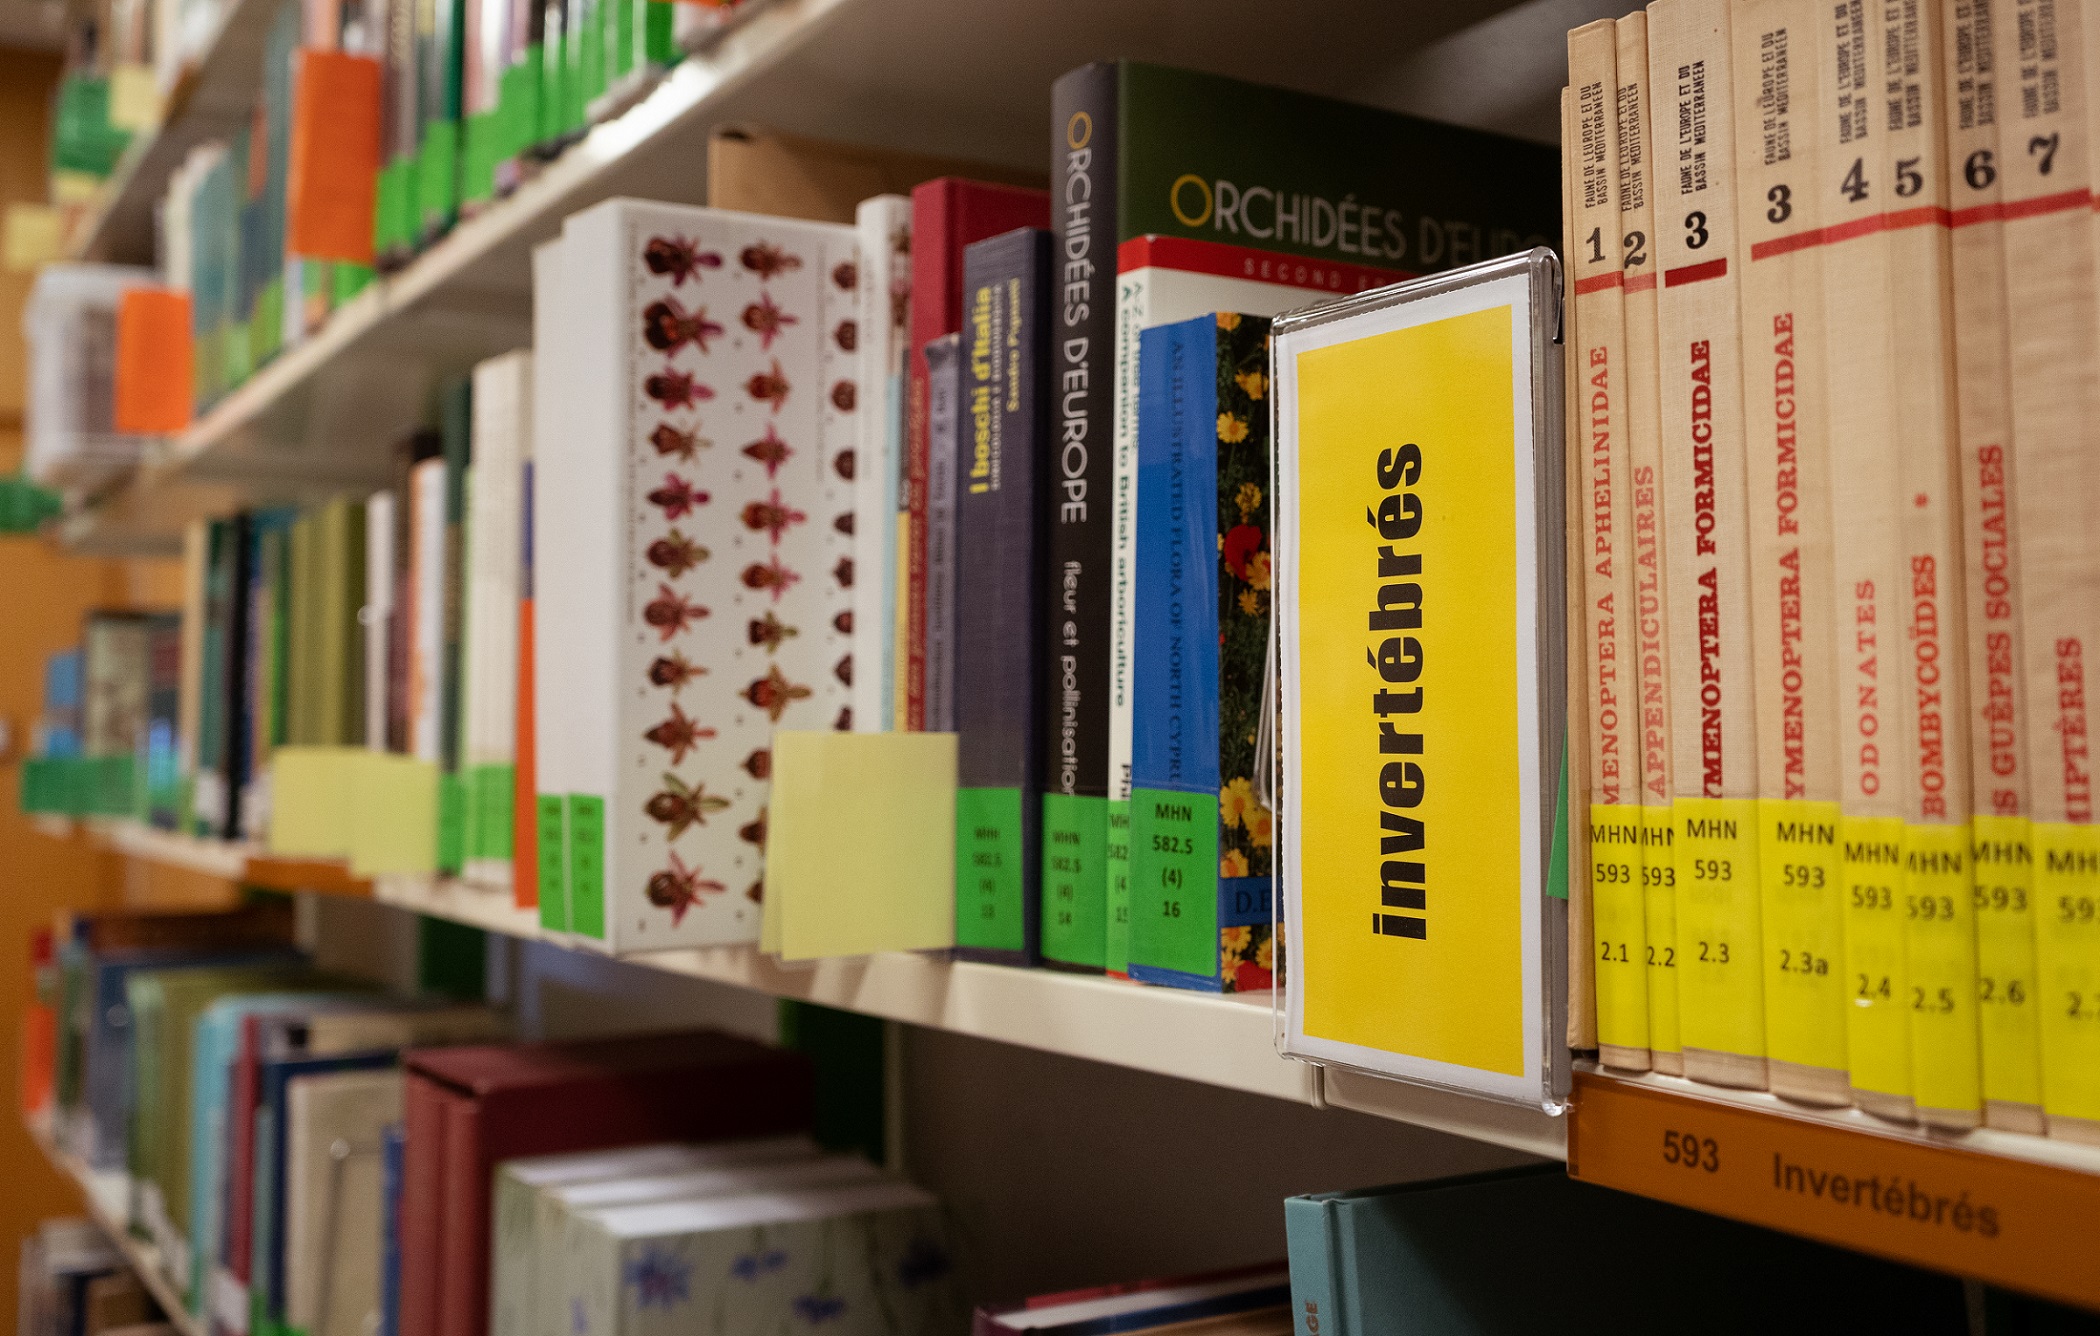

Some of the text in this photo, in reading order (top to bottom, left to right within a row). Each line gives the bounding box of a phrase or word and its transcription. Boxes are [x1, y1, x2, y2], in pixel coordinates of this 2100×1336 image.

[1678, 65, 1690, 80] DU
[1580, 85, 1591, 100] DU
[1679, 83, 1691, 96] ET
[1581, 102, 1592, 114] ET
[1763, 116, 1776, 131] DE
[1680, 147, 1692, 160] DE
[1764, 133, 1776, 165] FAUNE
[1778, 121, 1790, 161] BASSIN
[2028, 132, 2060, 176] 7
[1584, 164, 1595, 176] DE
[1620, 166, 1631, 181] DE
[1681, 165, 1693, 195] FAUNE
[1694, 152, 1707, 191] BASSIN
[1841, 158, 1870, 203] 4
[1895, 156, 1923, 197] 5
[1964, 149, 1996, 191] 6
[1584, 181, 1596, 208] FAUNE
[1596, 168, 1608, 205] BASSIN
[1621, 182, 1632, 212] FAUNE
[1632, 170, 1644, 209] BASSIN
[1170, 173, 1408, 260] ORCHIDÉES
[1767, 184, 1791, 223] 3
[1685, 211, 1709, 249] 3
[1586, 227, 1606, 264] 1
[1623, 231, 1647, 270] 2
[1061, 111, 1096, 524] ORCHIDÉES D'EUROPE
[971, 286, 991, 381] d'Italia
[969, 385, 990, 478] boschi
[1773, 312, 1799, 536] FORMICIDAE
[1590, 345, 1613, 579] APHELINIDAE
[1691, 340, 1717, 556] FORMICIDAE
[1116, 475, 1130, 550] British
[1978, 444, 2011, 620] SOCIALES
[1063, 560, 1083, 614] fleur
[1062, 620, 1080, 647] et
[1634, 465, 1666, 799] APPENDICULAIRES
[1367, 443, 1427, 941] invertébrés
[1856, 579, 1880, 797] ODONATES
[1908, 553, 1946, 819] BOMBYCOÏDES
[1982, 631, 2017, 777] GUÊPES
[1155, 803, 1193, 823] MHN
[1591, 824, 1637, 844] MHN
[1686, 818, 1738, 840] MHN
[1776, 821, 1835, 845] MHN
[1152, 834, 1193, 856] 582.5
[1843, 841, 1900, 865] MHN
[1596, 863, 1631, 884] 593
[1694, 859, 1733, 881] 593
[1783, 864, 1825, 889] 593
[2046, 850, 2100, 875] MH
[1161, 867, 1183, 889] (4)
[1163, 900, 1181, 919] 16
[1852, 885, 1893, 911] 593
[1974, 885, 2028, 913] 593
[2059, 896, 2100, 924] 59
[1600, 941, 1629, 963] 2.1
[1647, 946, 1676, 967] 2.2
[1698, 941, 1730, 964] 2.3
[1780, 949, 1829, 976] 2.3a
[1857, 973, 1891, 1000] 2.4
[1912, 986, 1955, 1013] 2.5
[1980, 978, 2026, 1006] 2.6
[1662, 1130, 2001, 1239] 593 Invertébrés
